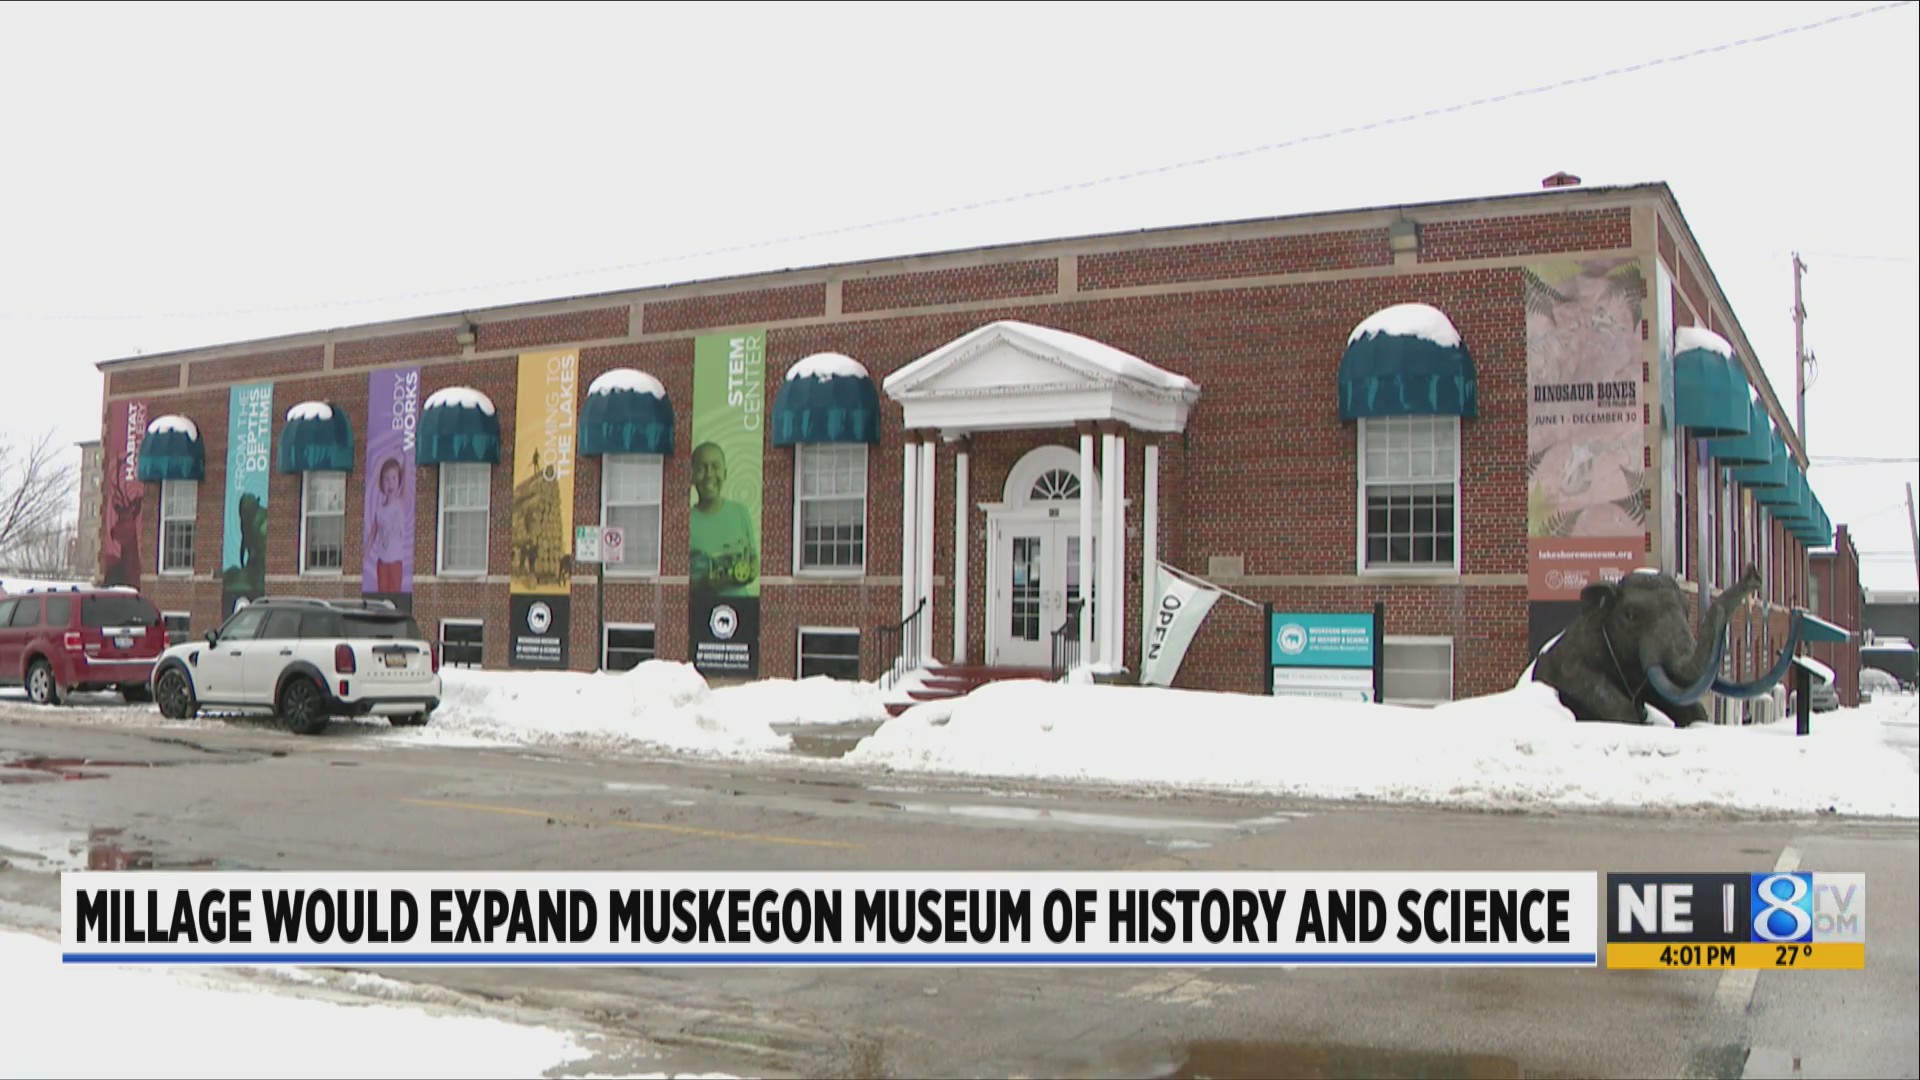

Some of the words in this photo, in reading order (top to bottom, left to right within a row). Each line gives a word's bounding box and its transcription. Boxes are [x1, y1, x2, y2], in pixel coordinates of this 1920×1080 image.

[547, 357, 561, 382] TO
[559, 354, 575, 428] LAKES
[728, 337, 745, 408] STEM
[743, 335, 761, 431] CENTER
[1534, 383, 1594, 403] DINOSAUR
[1597, 381, 1636, 400] BONES
[238, 391, 250, 429] THE
[246, 388, 260, 472] DEPTHS
[258, 387, 271, 437] TIME
[392, 374, 406, 430] BODY
[403, 371, 418, 451] WORKS
[1535, 415, 1557, 426] JUNE
[1572, 412, 1623, 425] DECEMBER
[125, 402, 138, 481] HABITAT
[235, 434, 247, 491] FROM
[256, 447, 268, 471] OF
[543, 393, 560, 481] COMING
[557, 436, 572, 480] THE
[1538, 550, 1633, 560] lakeshoremuseum.org
[1148, 594, 1182, 660] OPEN
